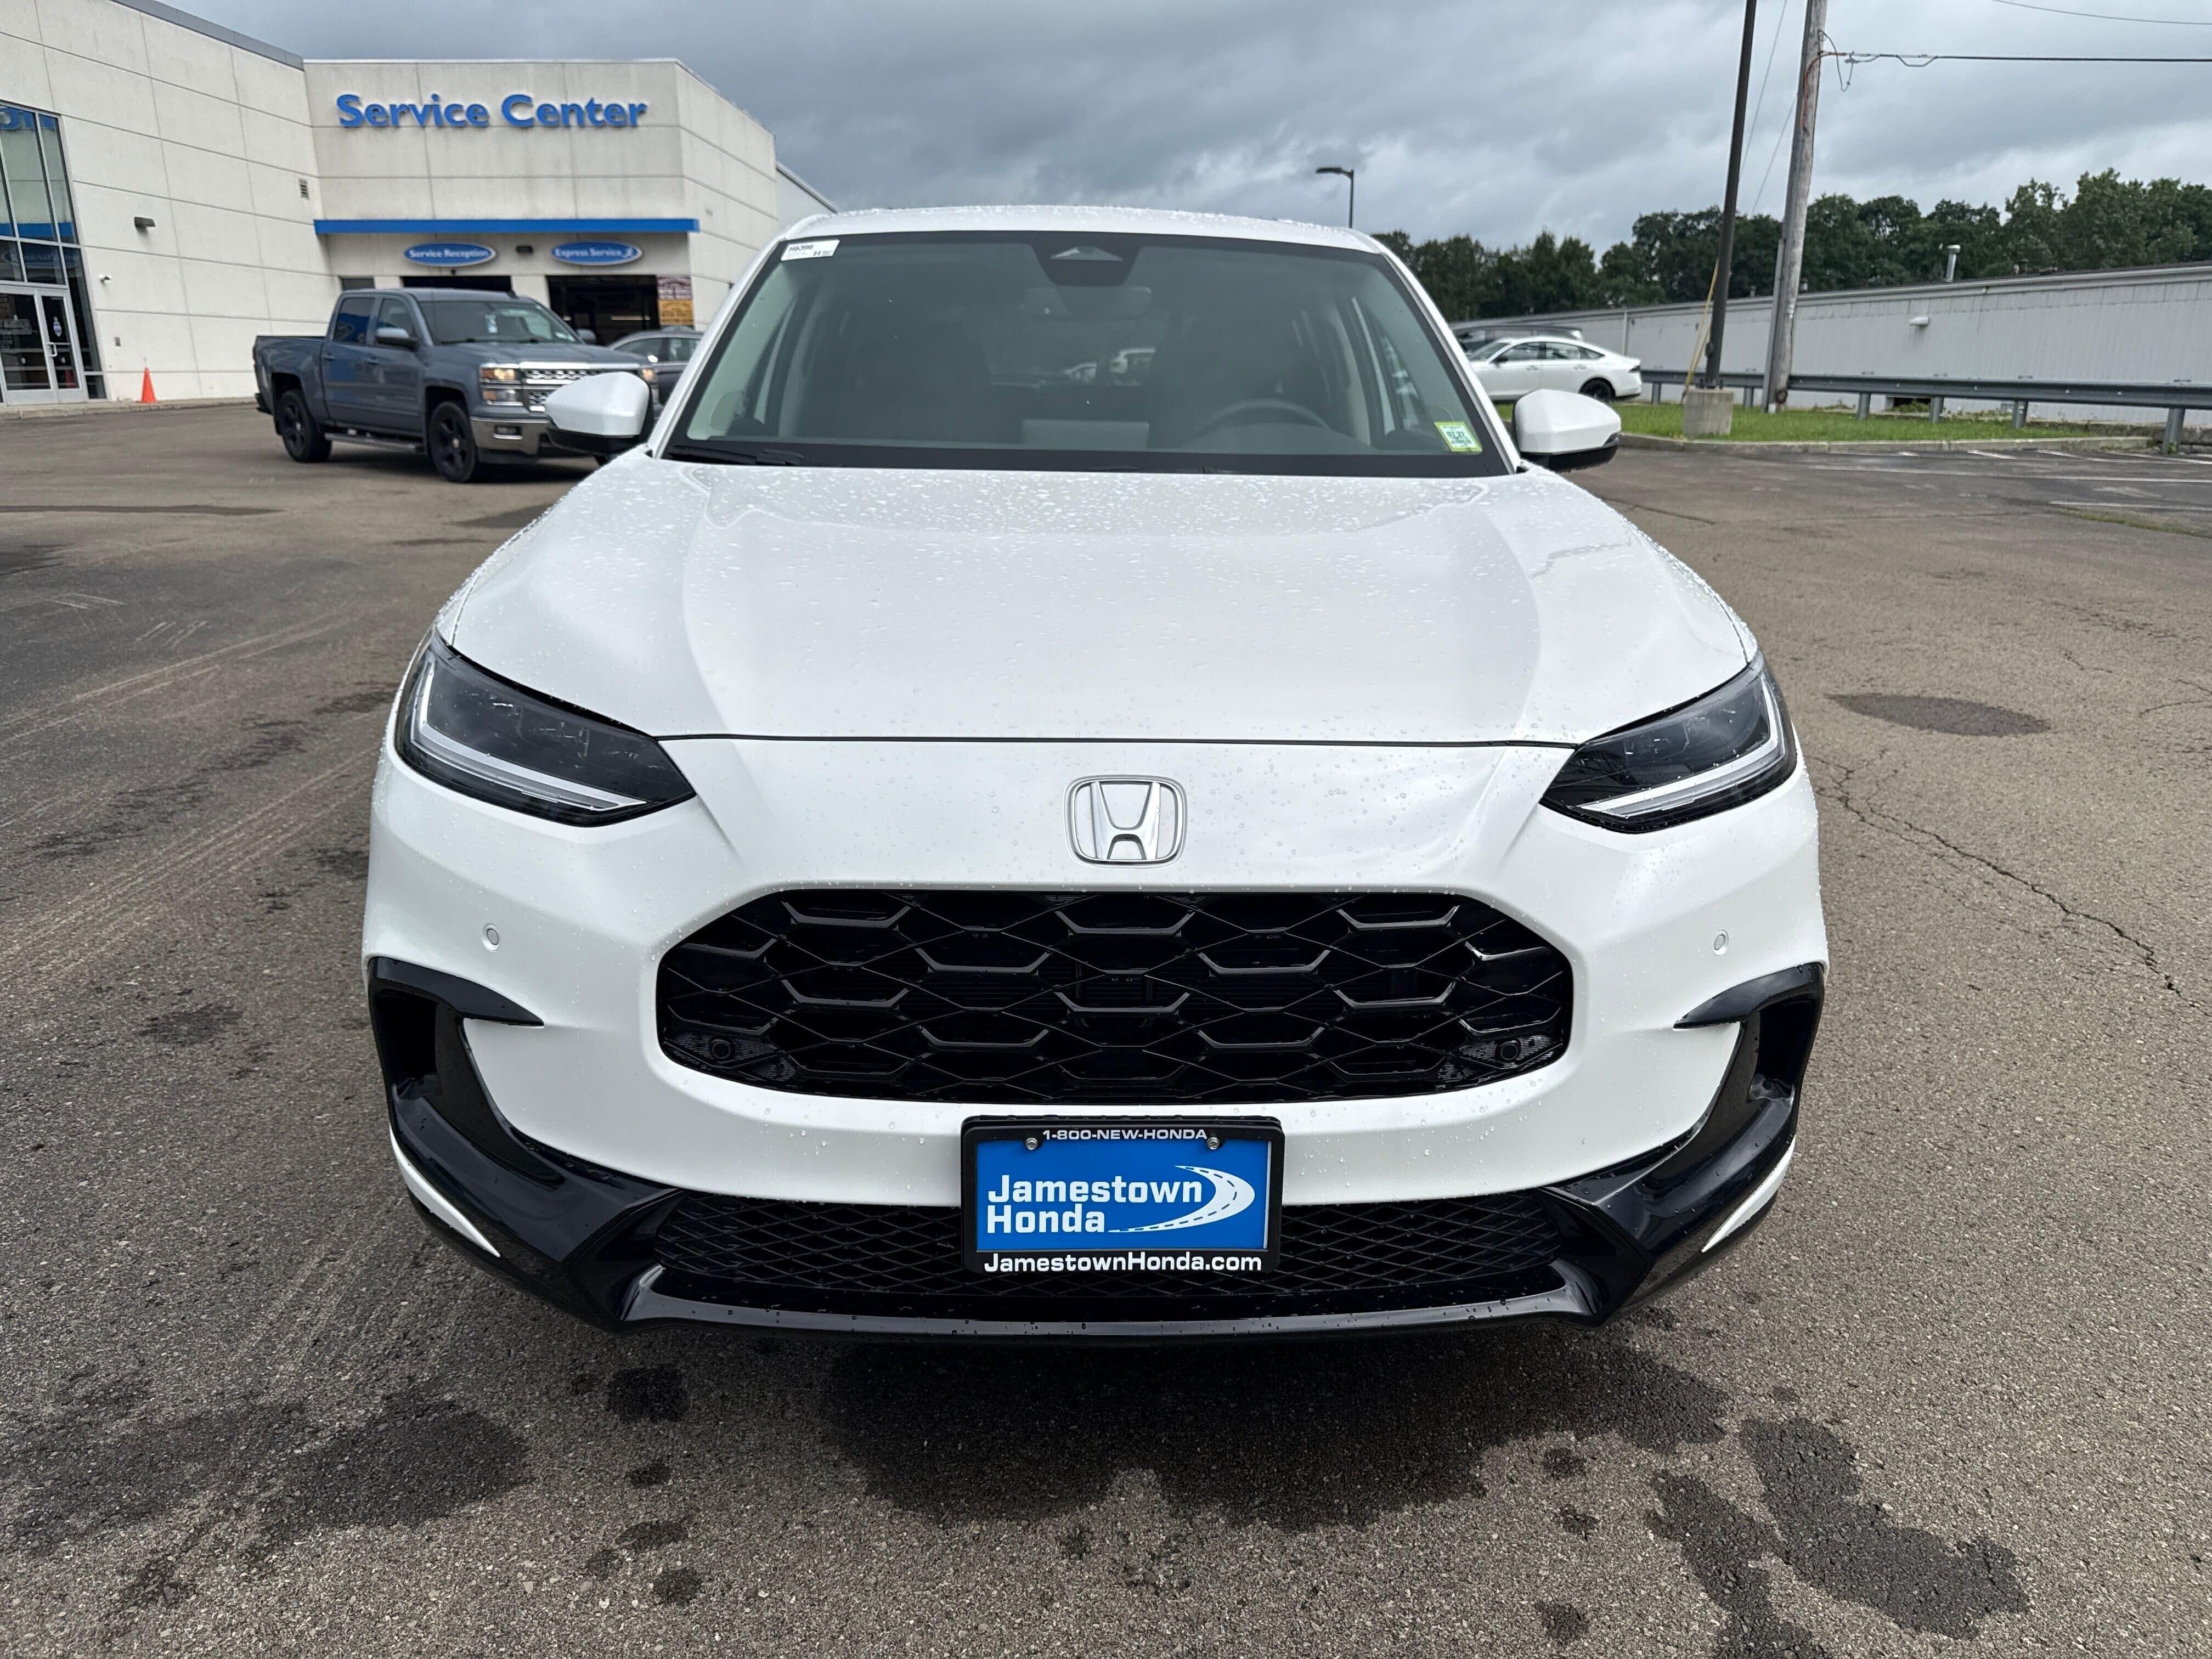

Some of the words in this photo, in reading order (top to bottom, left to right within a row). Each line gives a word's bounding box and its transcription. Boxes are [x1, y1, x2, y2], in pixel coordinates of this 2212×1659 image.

[336, 93, 490, 128] Service
[501, 93, 648, 128] Center
[409, 249, 443, 258] Service
[443, 248, 489, 259] Reception
[555, 248, 589, 259] Express
[589, 247, 622, 257] Service
[1042, 1128, 1207, 1141] 1-800-NEW-HONDA
[988, 1174, 1202, 1203] Jamestown
[987, 1203, 1105, 1233] Honda
[984, 1251, 1262, 1272] JamestownHonda.com
